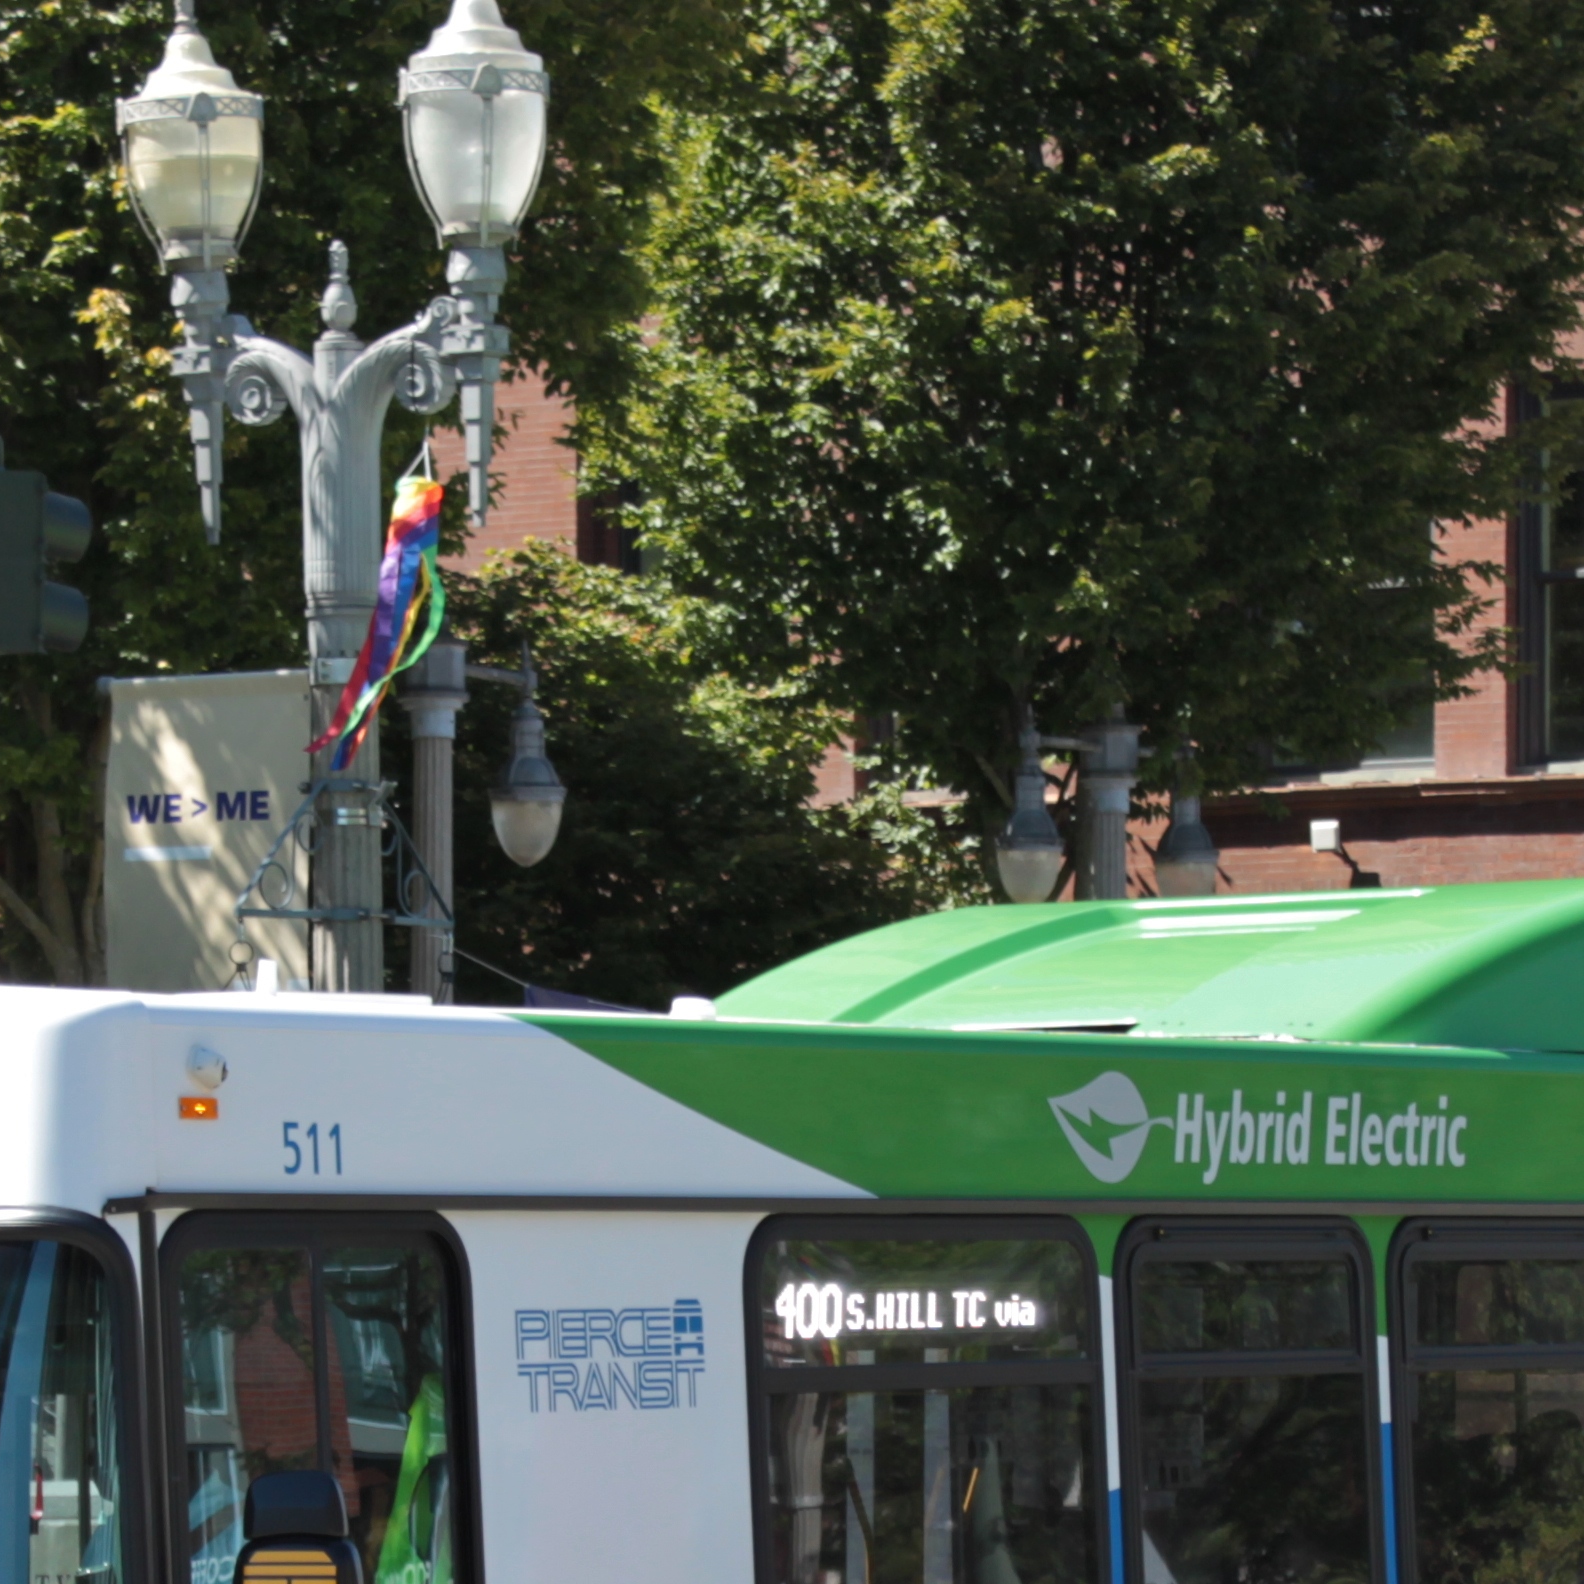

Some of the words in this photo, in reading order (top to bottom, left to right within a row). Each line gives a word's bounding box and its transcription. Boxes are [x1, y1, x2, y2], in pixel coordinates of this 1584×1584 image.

[127, 793, 183, 824] WE
[216, 790, 270, 821] ME
[282, 1121, 342, 1175] 511
[1174, 1089, 1312, 1185] Hybrid
[1325, 1092, 1467, 1167] Electric
[515, 1308, 673, 1360] PIERCE
[776, 1283, 843, 1339] 400
[952, 1291, 987, 1327] TC
[994, 1294, 1036, 1327] via
[518, 1359, 705, 1413] TRANSIT
